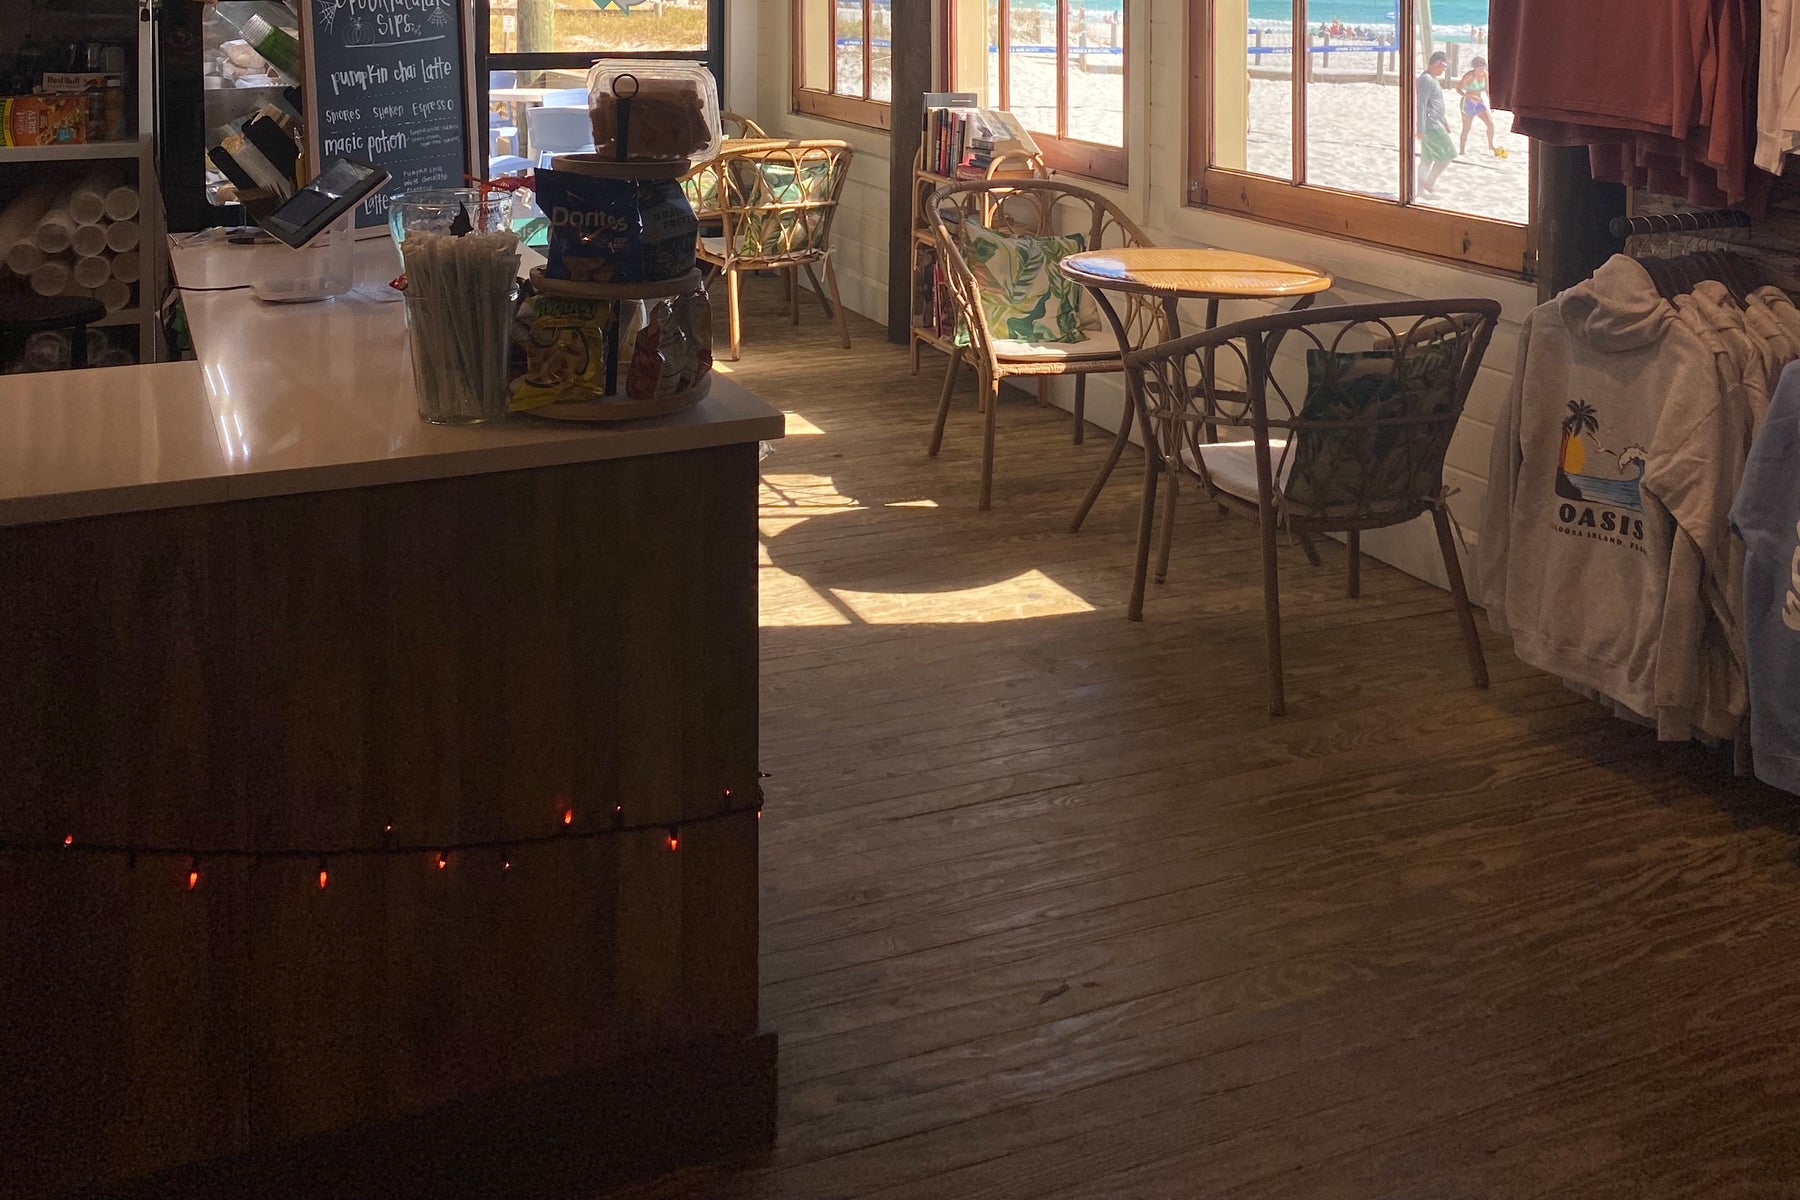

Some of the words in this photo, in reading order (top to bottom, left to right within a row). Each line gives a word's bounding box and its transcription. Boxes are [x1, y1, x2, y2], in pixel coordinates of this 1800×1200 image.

[394, 59, 417, 83] chai
[552, 205, 629, 232] Doritos
[1558, 502, 1644, 541] OASIS
